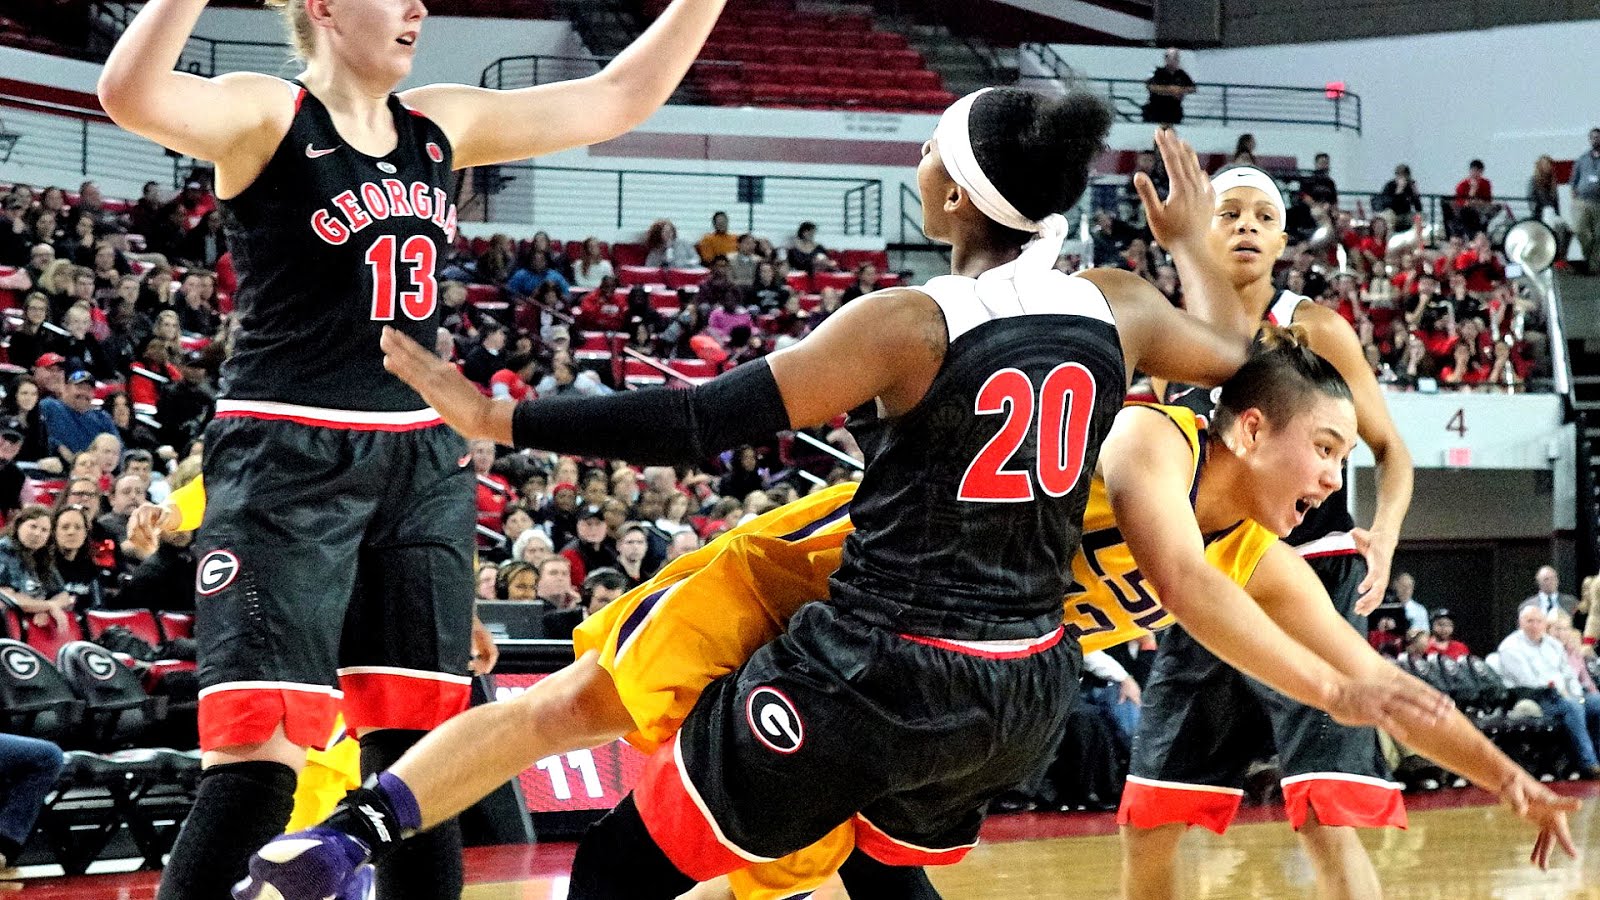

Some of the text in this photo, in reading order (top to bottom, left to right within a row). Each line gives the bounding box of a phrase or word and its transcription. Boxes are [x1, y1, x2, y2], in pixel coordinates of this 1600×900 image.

[310, 179, 458, 246] GEORGIA
[365, 234, 438, 321] 13
[956, 361, 1097, 503] 20
[1446, 408, 1468, 437] 4
[535, 748, 604, 801] 11
